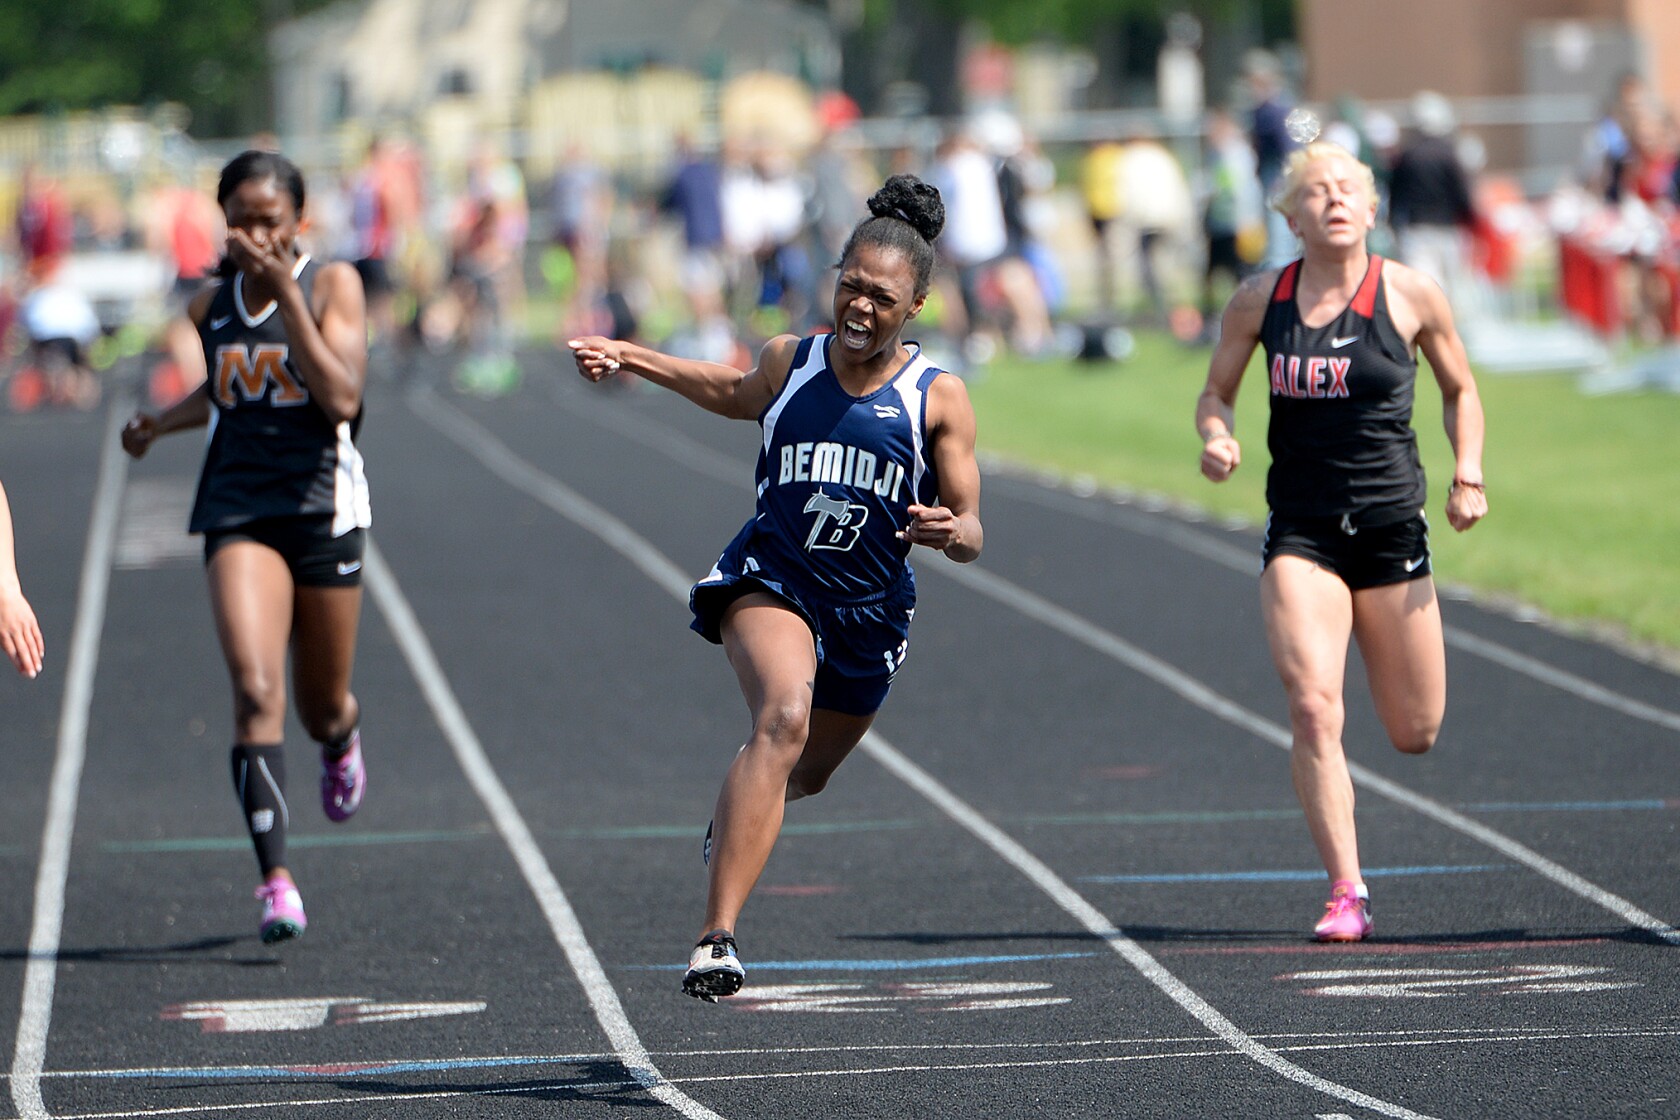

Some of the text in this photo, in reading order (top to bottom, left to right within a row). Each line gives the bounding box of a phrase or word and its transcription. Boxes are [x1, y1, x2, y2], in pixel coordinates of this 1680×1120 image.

[213, 342, 309, 409] M
[1271, 353, 1352, 399] ALEX
[778, 441, 905, 503] BEMIDJI
